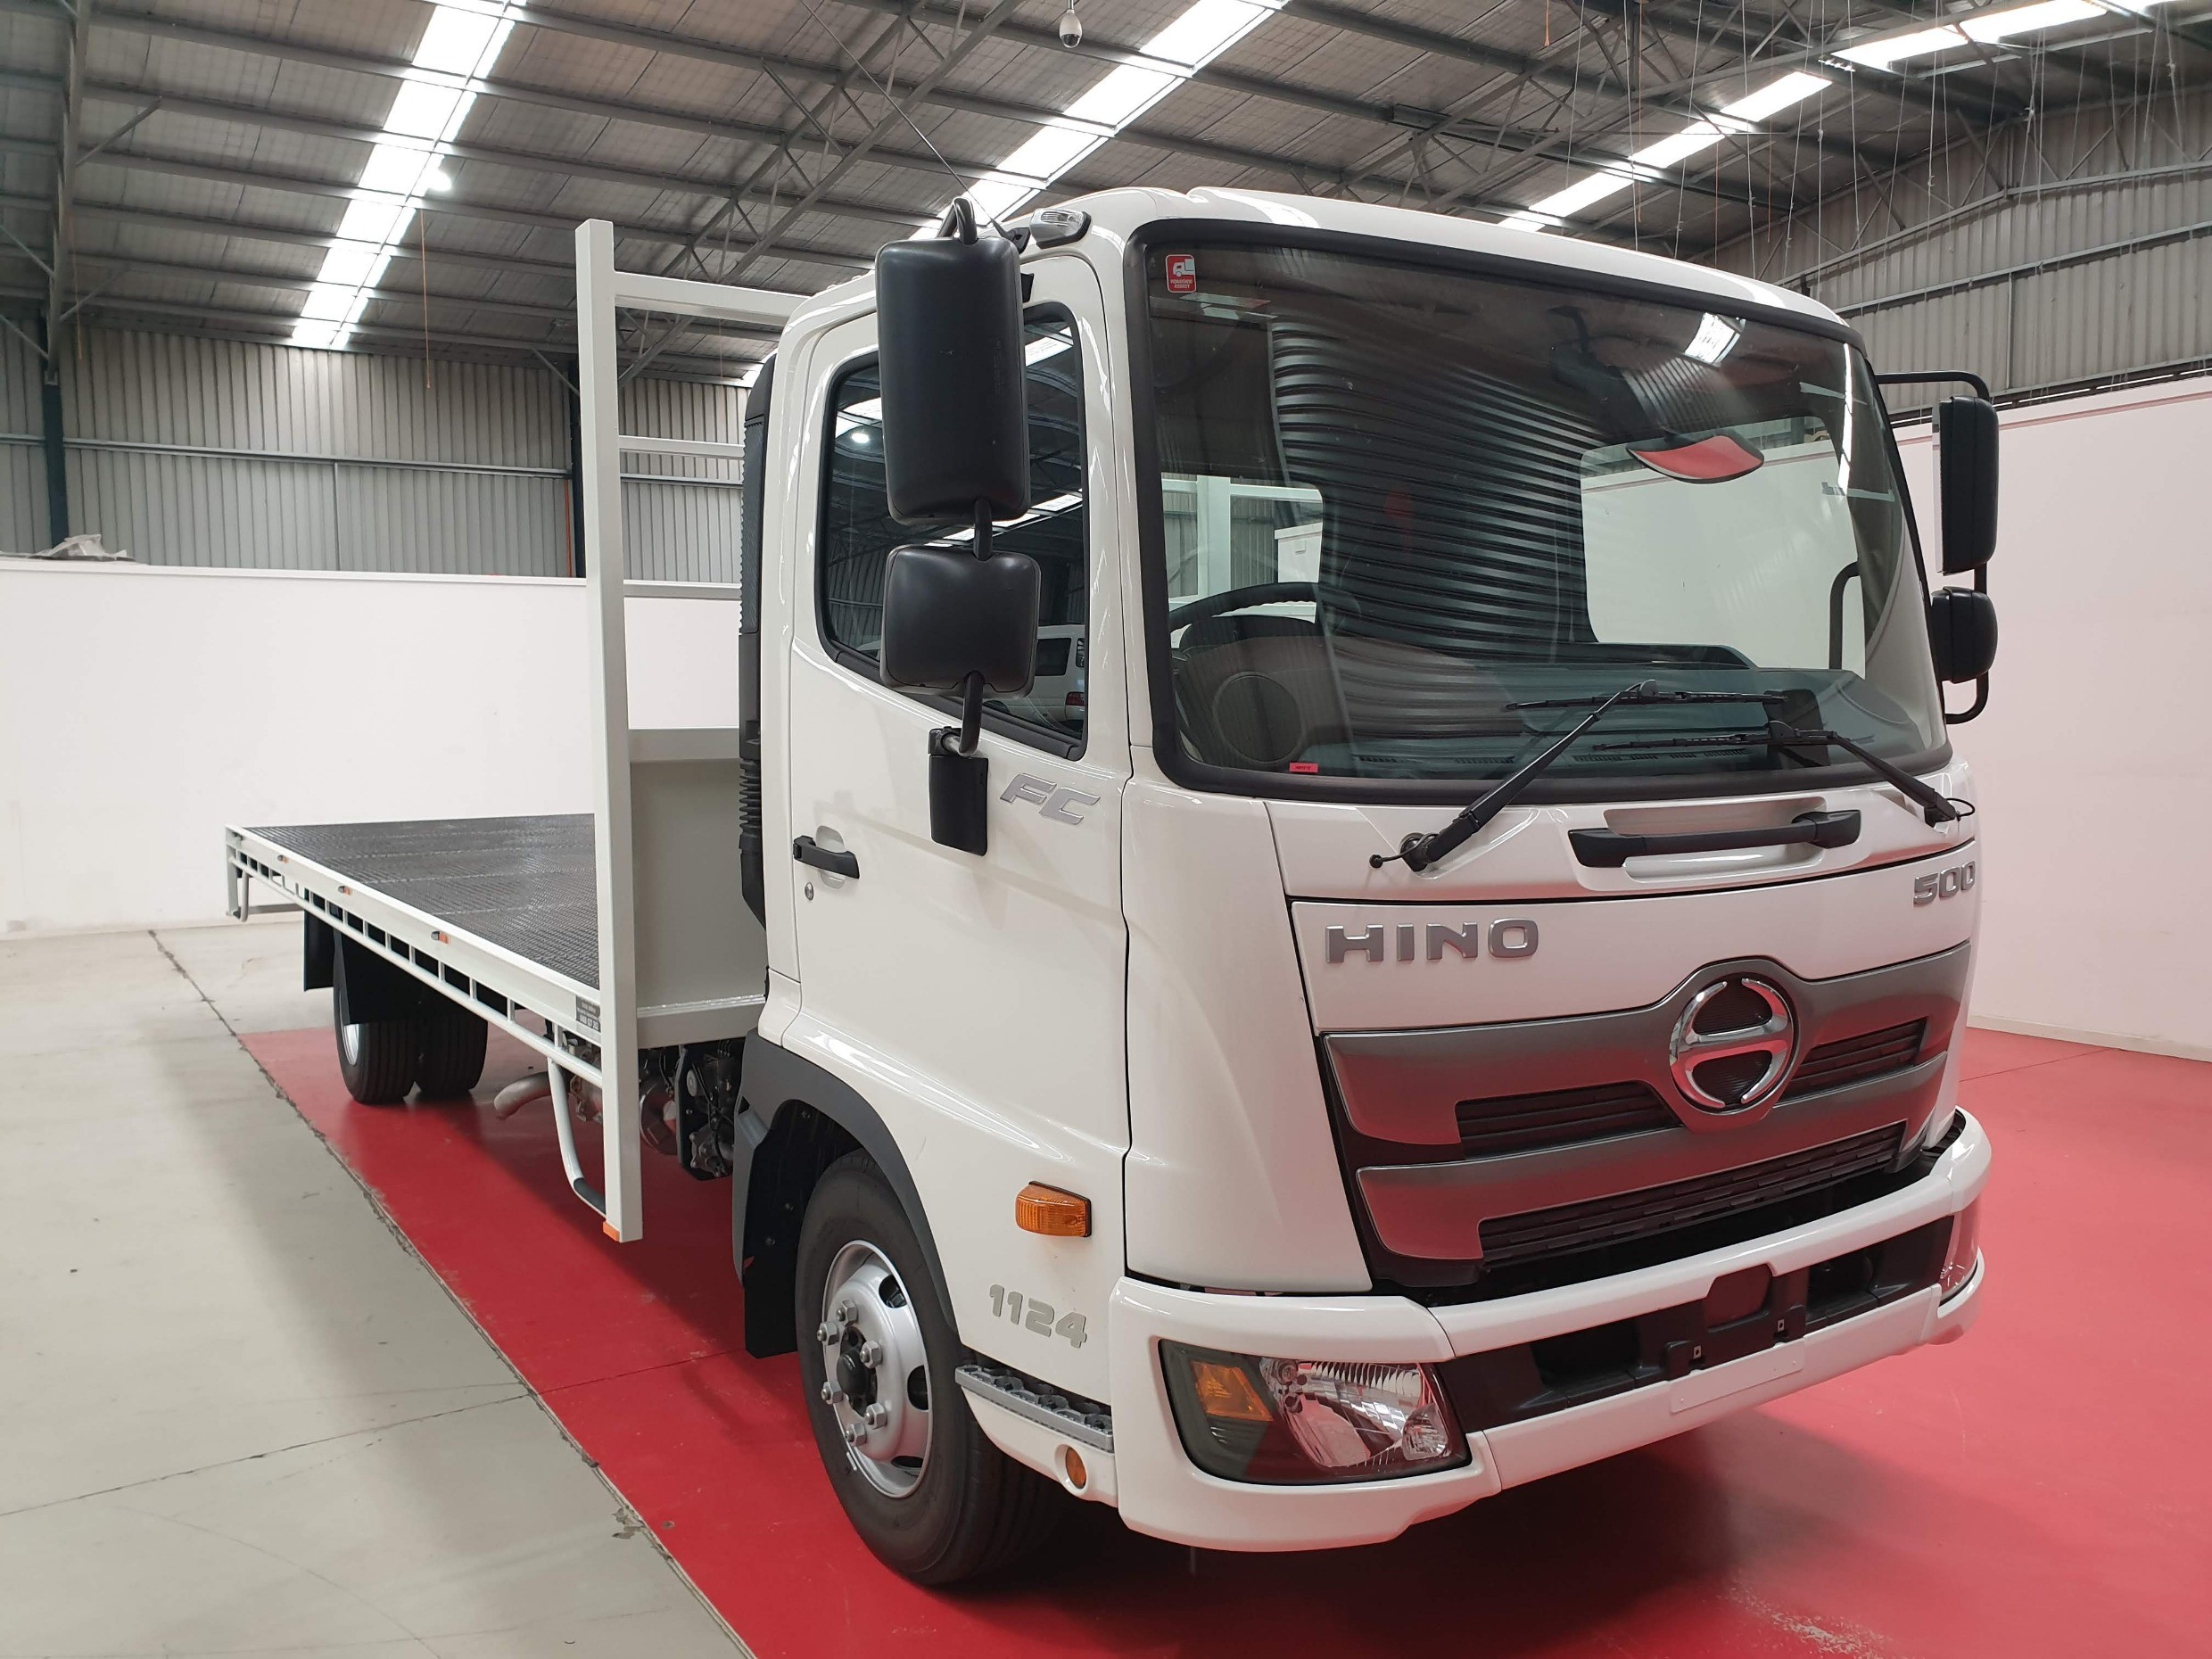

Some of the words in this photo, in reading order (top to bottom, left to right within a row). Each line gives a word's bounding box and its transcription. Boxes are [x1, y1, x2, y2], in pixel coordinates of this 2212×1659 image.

[999, 772, 1101, 825] FC
[1913, 861, 1976, 906] 500
[1325, 918, 1539, 963] HINO
[989, 1283, 1087, 1349] 1124
